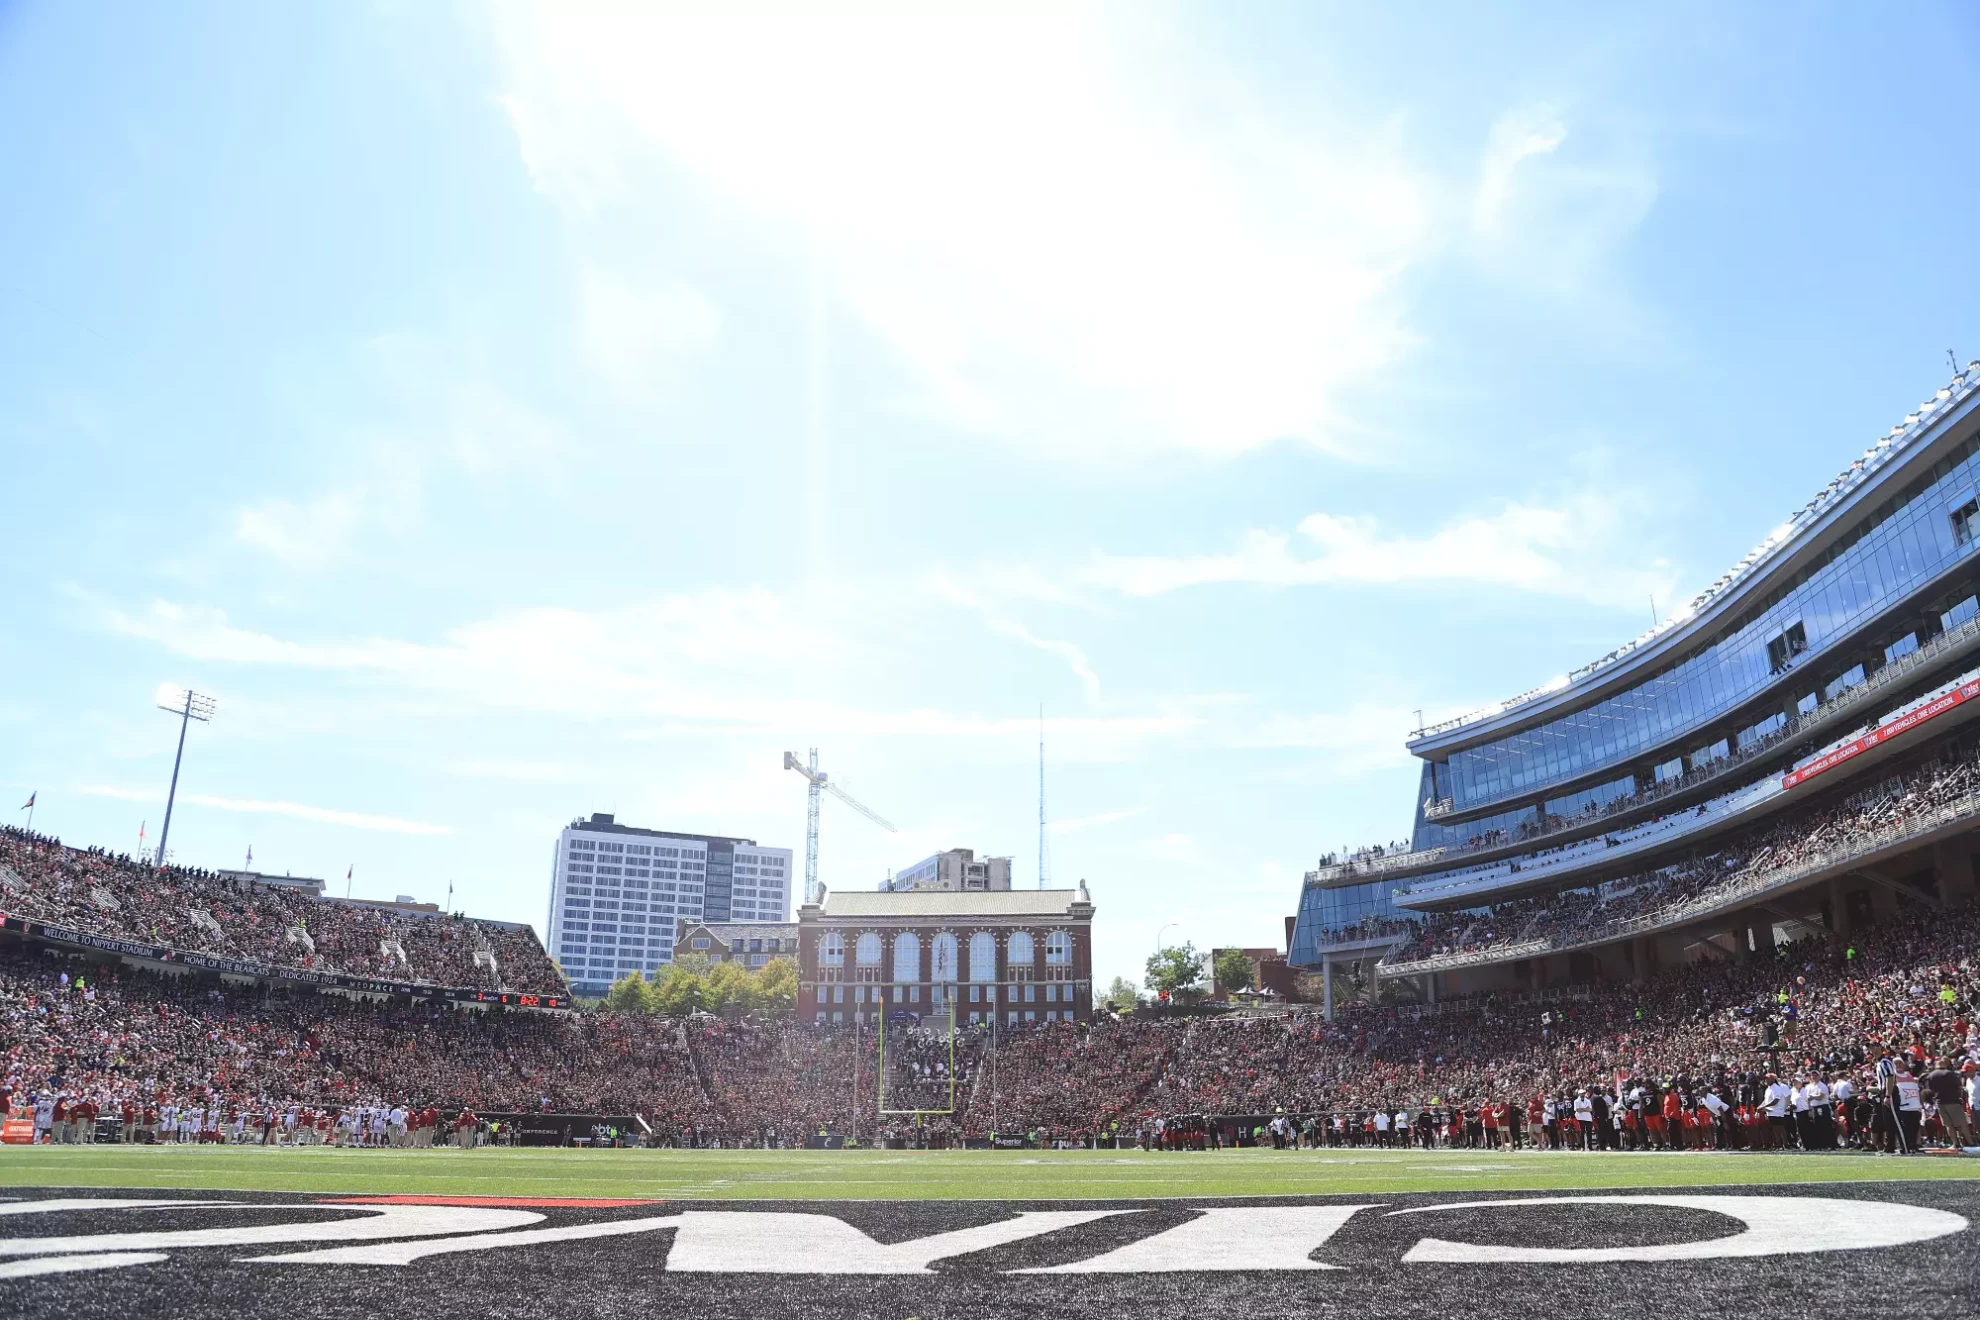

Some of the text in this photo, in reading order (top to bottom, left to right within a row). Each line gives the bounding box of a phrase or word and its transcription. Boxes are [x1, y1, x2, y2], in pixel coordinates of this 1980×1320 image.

[43, 927, 79, 943] WELCOME
[81, 935, 91, 945] TO
[92, 939, 120, 952] NIPPERT
[121, 944, 153, 957] STADIUM
[184, 955, 270, 976] HOME OF THE BEARCATS
[280, 970, 338, 985] DEDICATED 1924
[349, 981, 394, 993] MEDPACE
[502, 995, 507, 1003] 6
[520, 995, 539, 1006] 8:22
[1645, 1098, 1651, 1106] 9
[995, 1137, 1023, 1147] Superior
